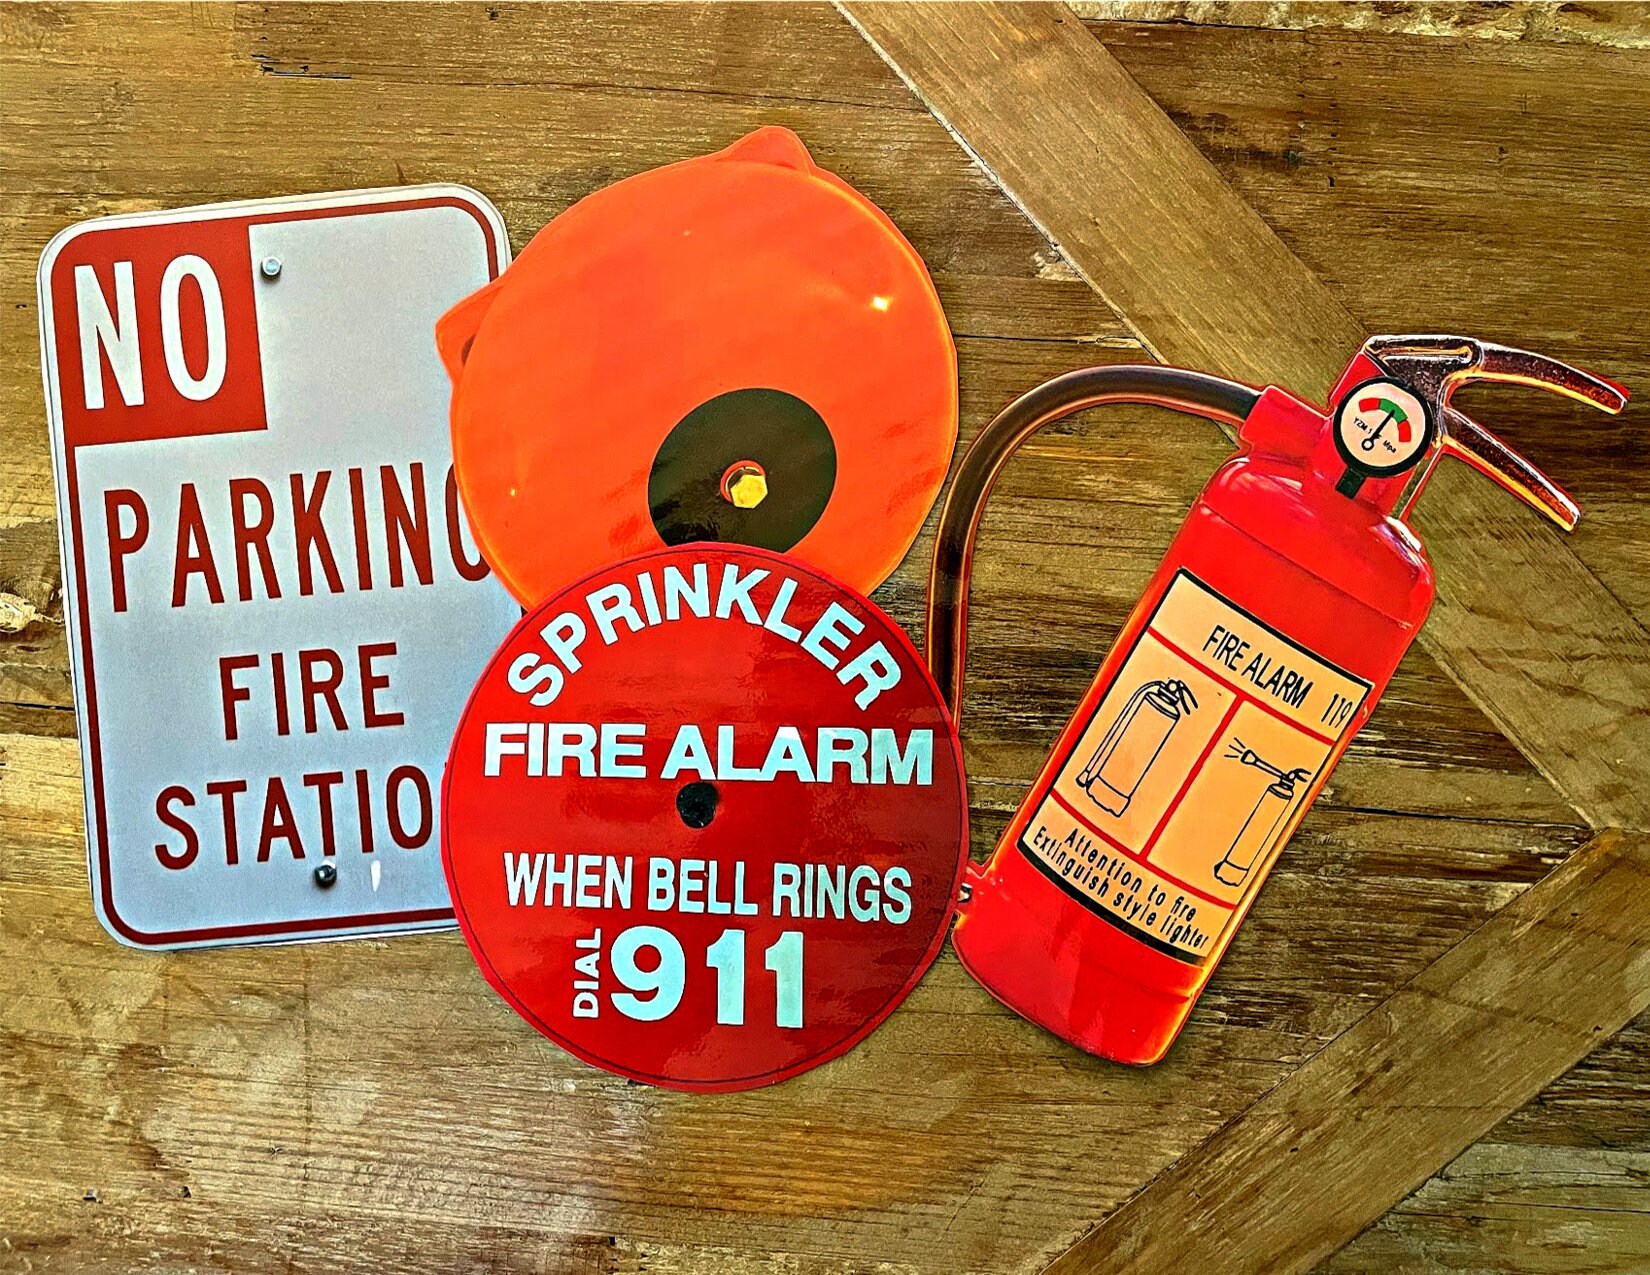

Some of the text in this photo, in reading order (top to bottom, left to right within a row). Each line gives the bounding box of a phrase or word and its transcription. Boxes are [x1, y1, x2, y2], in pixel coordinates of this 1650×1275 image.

[73, 254, 228, 410] NO
[507, 563, 902, 711] SPRINKLER
[1202, 624, 1353, 728] FIRE ALARM 119
[218, 641, 405, 741] FIRE
[484, 723, 934, 786] FIRE ALARM
[154, 763, 434, 870] STATIO
[503, 852, 912, 924] WHEN BELL RINGS
[1033, 825, 1209, 949] Extinguish style lighter
[1064, 828, 1197, 922] Attention to fire
[573, 928, 602, 1019] DIAL
[610, 924, 805, 1030] 911
